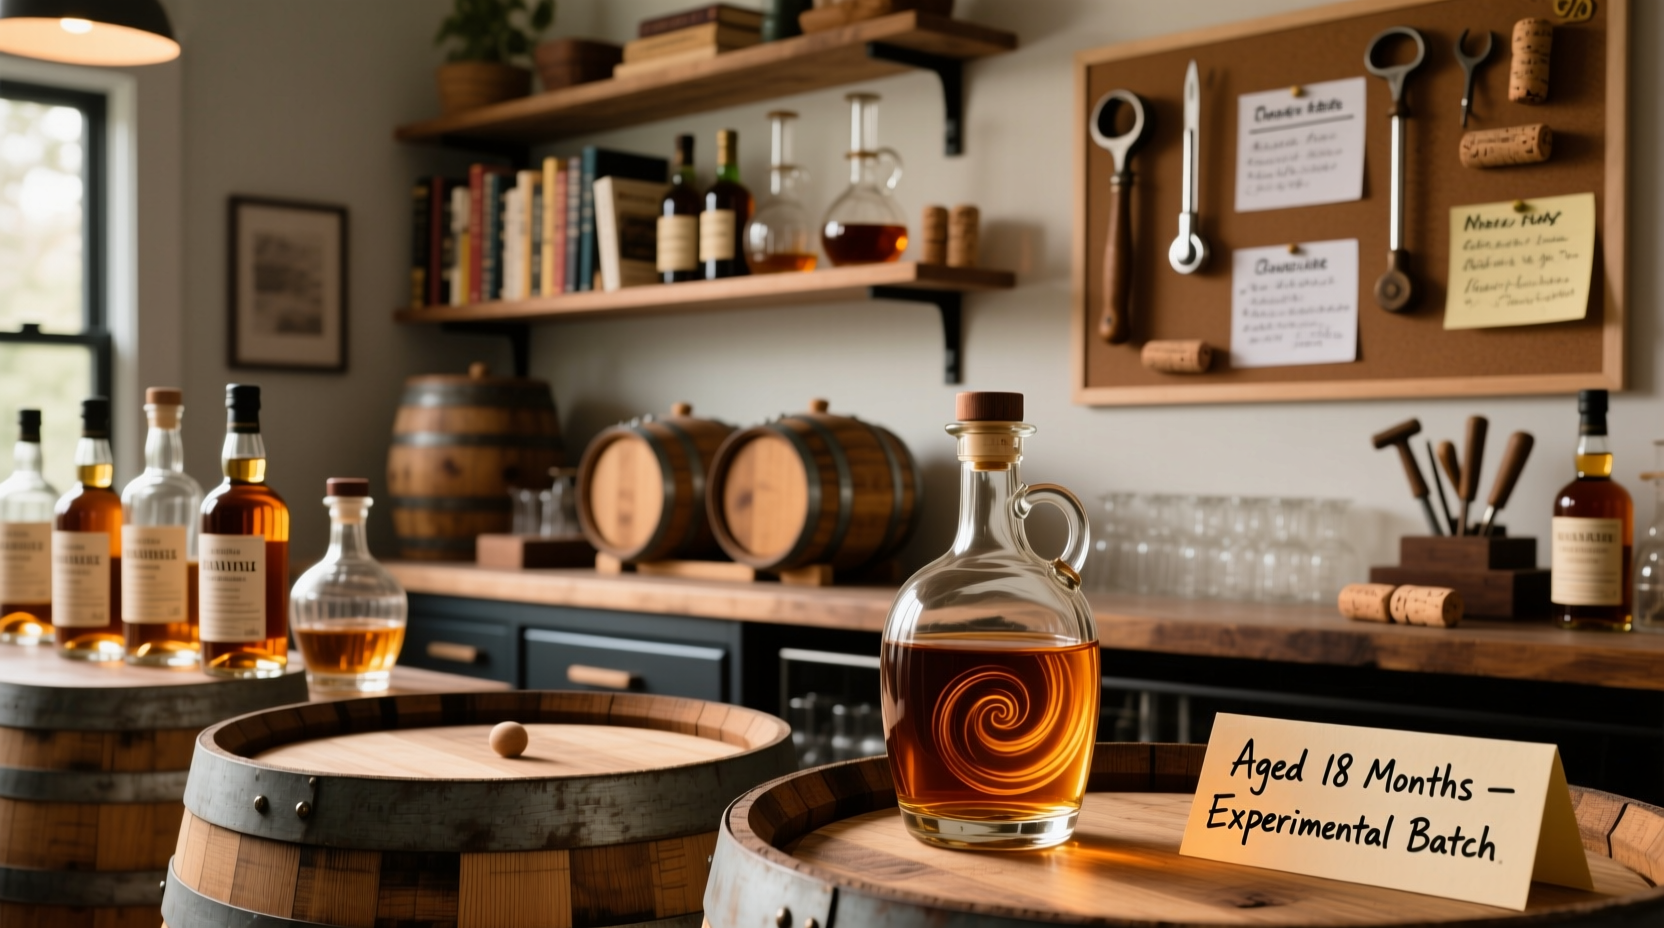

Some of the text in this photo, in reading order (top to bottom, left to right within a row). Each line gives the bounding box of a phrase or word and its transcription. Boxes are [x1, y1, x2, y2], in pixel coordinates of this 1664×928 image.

[1230, 737, 1309, 796] Aged
[1321, 752, 1354, 788] 18
[1363, 758, 1474, 802] Months
[1206, 793, 1496, 862] Experimental Batch
